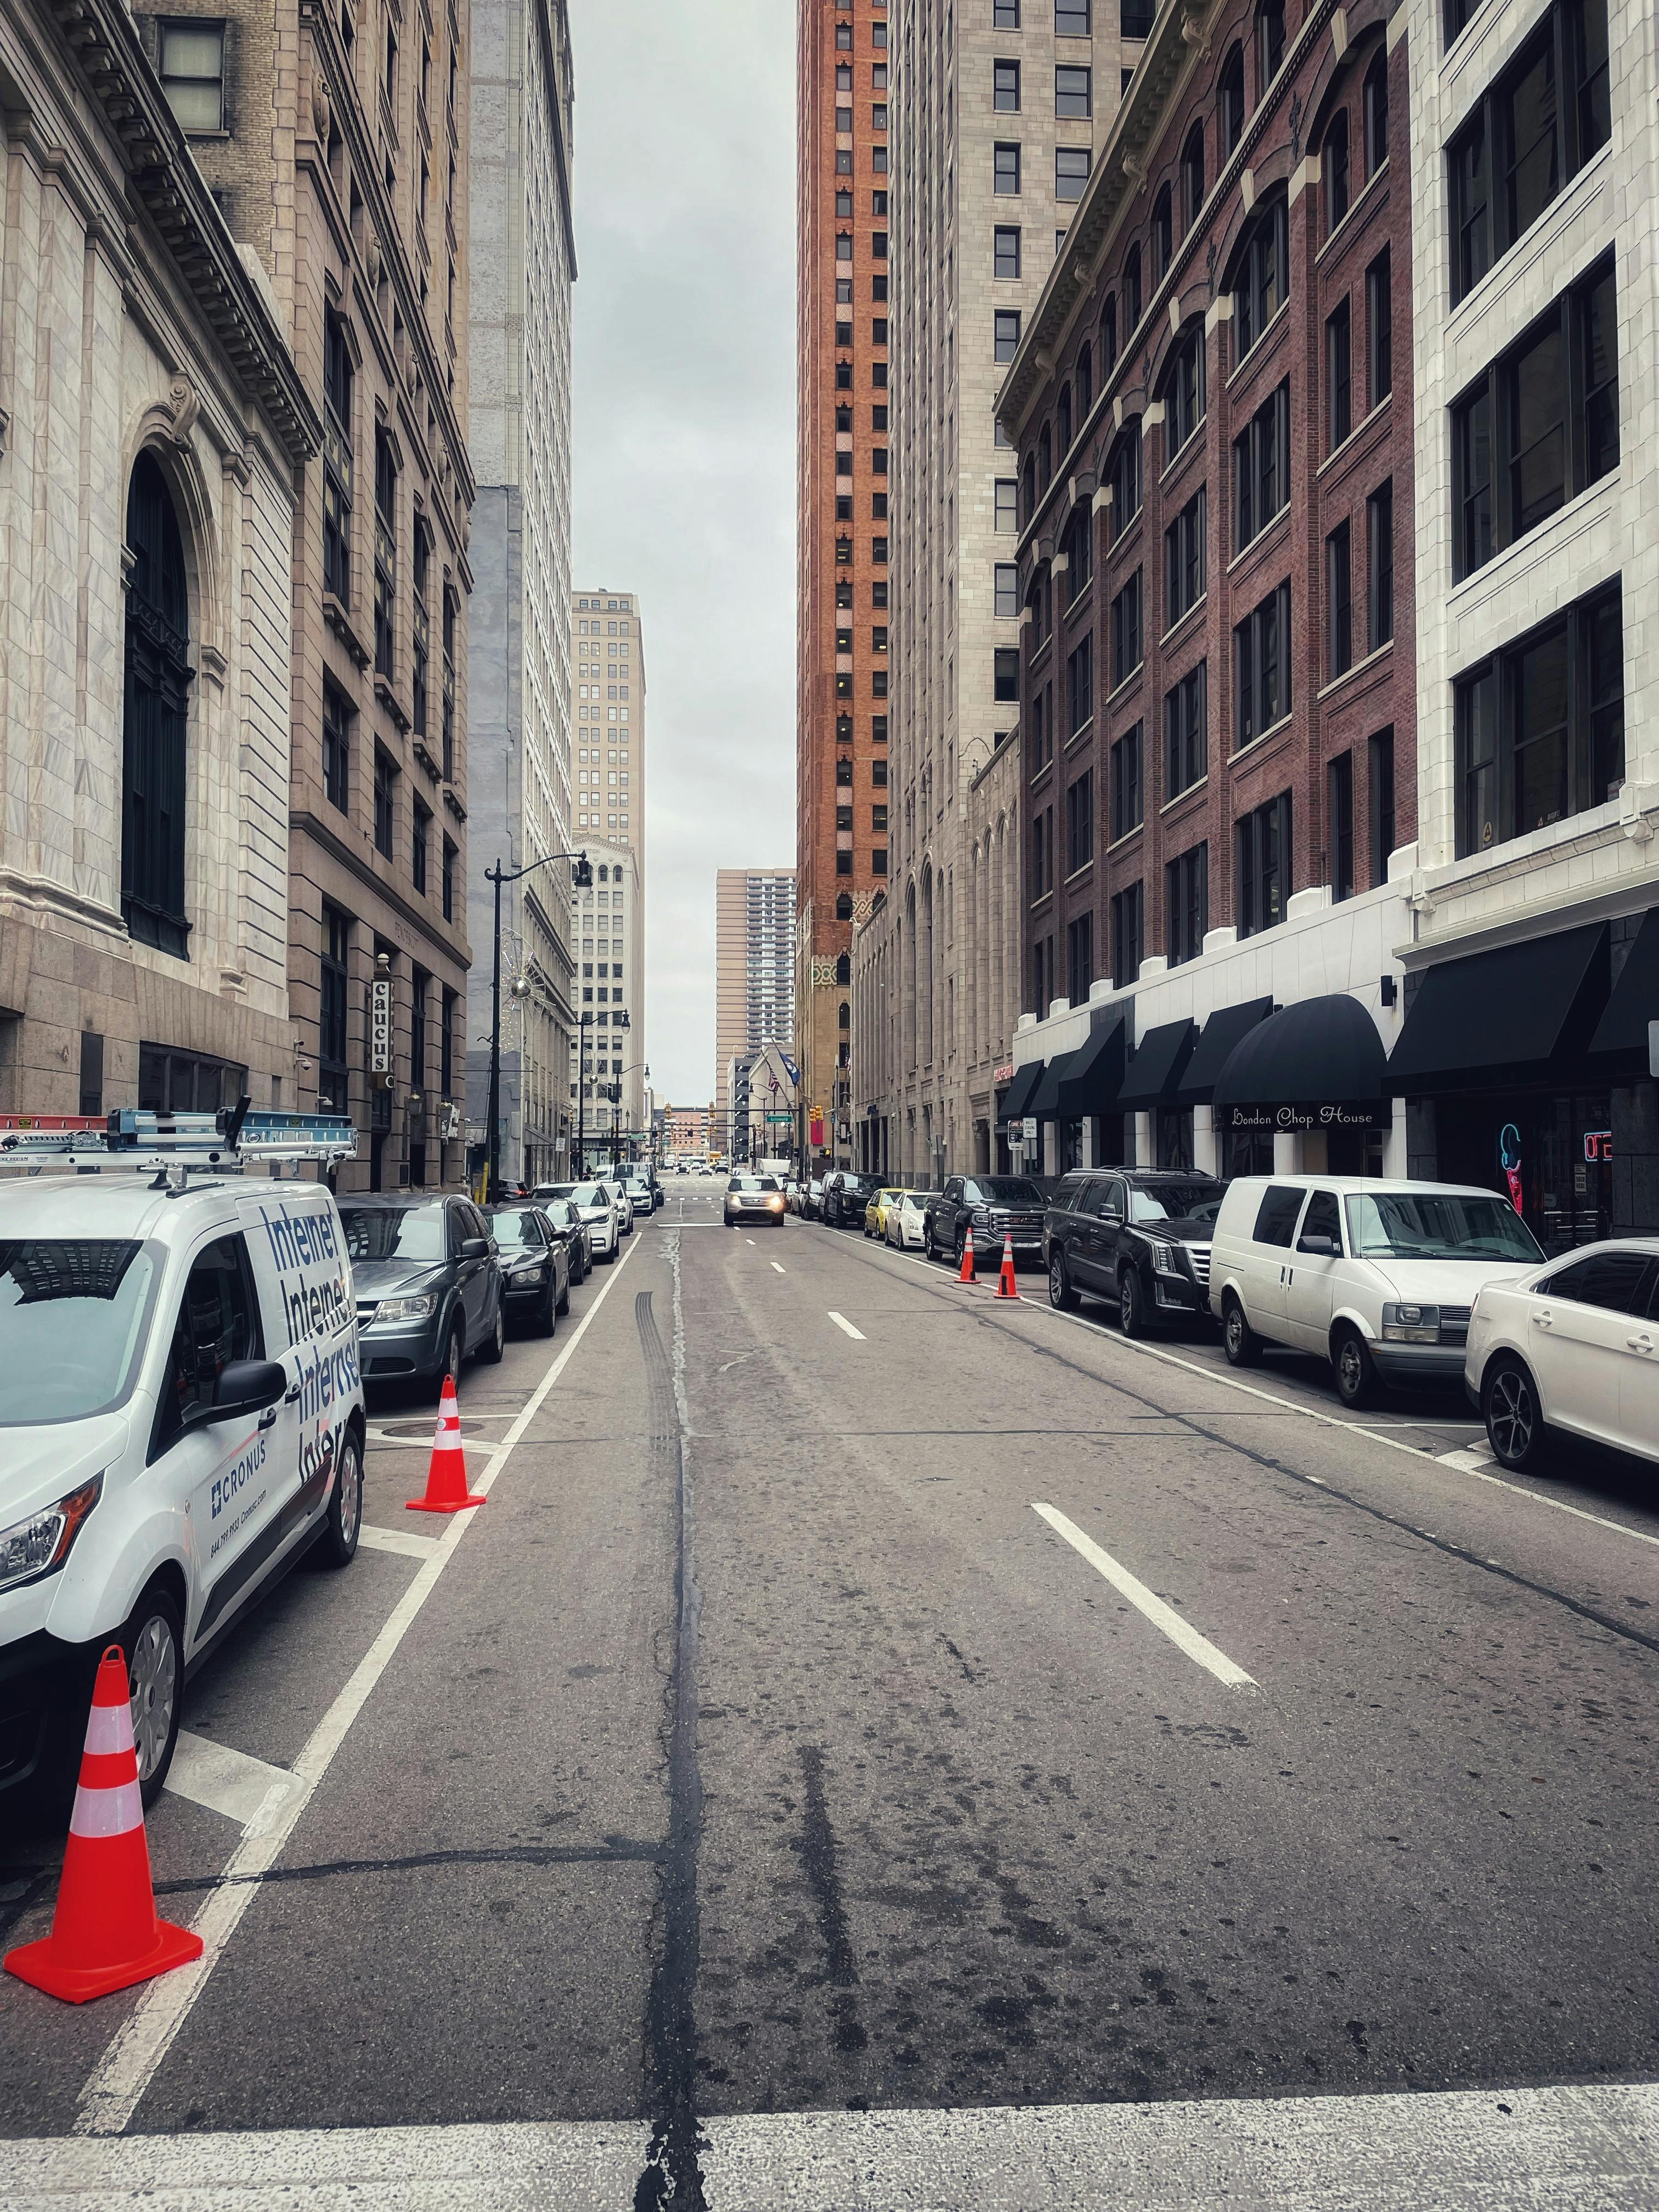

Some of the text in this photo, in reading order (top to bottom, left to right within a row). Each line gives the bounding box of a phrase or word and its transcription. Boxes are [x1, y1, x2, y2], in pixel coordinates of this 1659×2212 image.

[374, 984, 386, 1070] caucus
[1232, 1106, 1373, 1129] London Chop House
[258, 1199, 338, 1272] Internet
[280, 1261, 352, 1348] Internet
[295, 1324, 359, 1425] Internet
[223, 1439, 266, 1503] CRONUS
[298, 1419, 347, 1483] Inter
